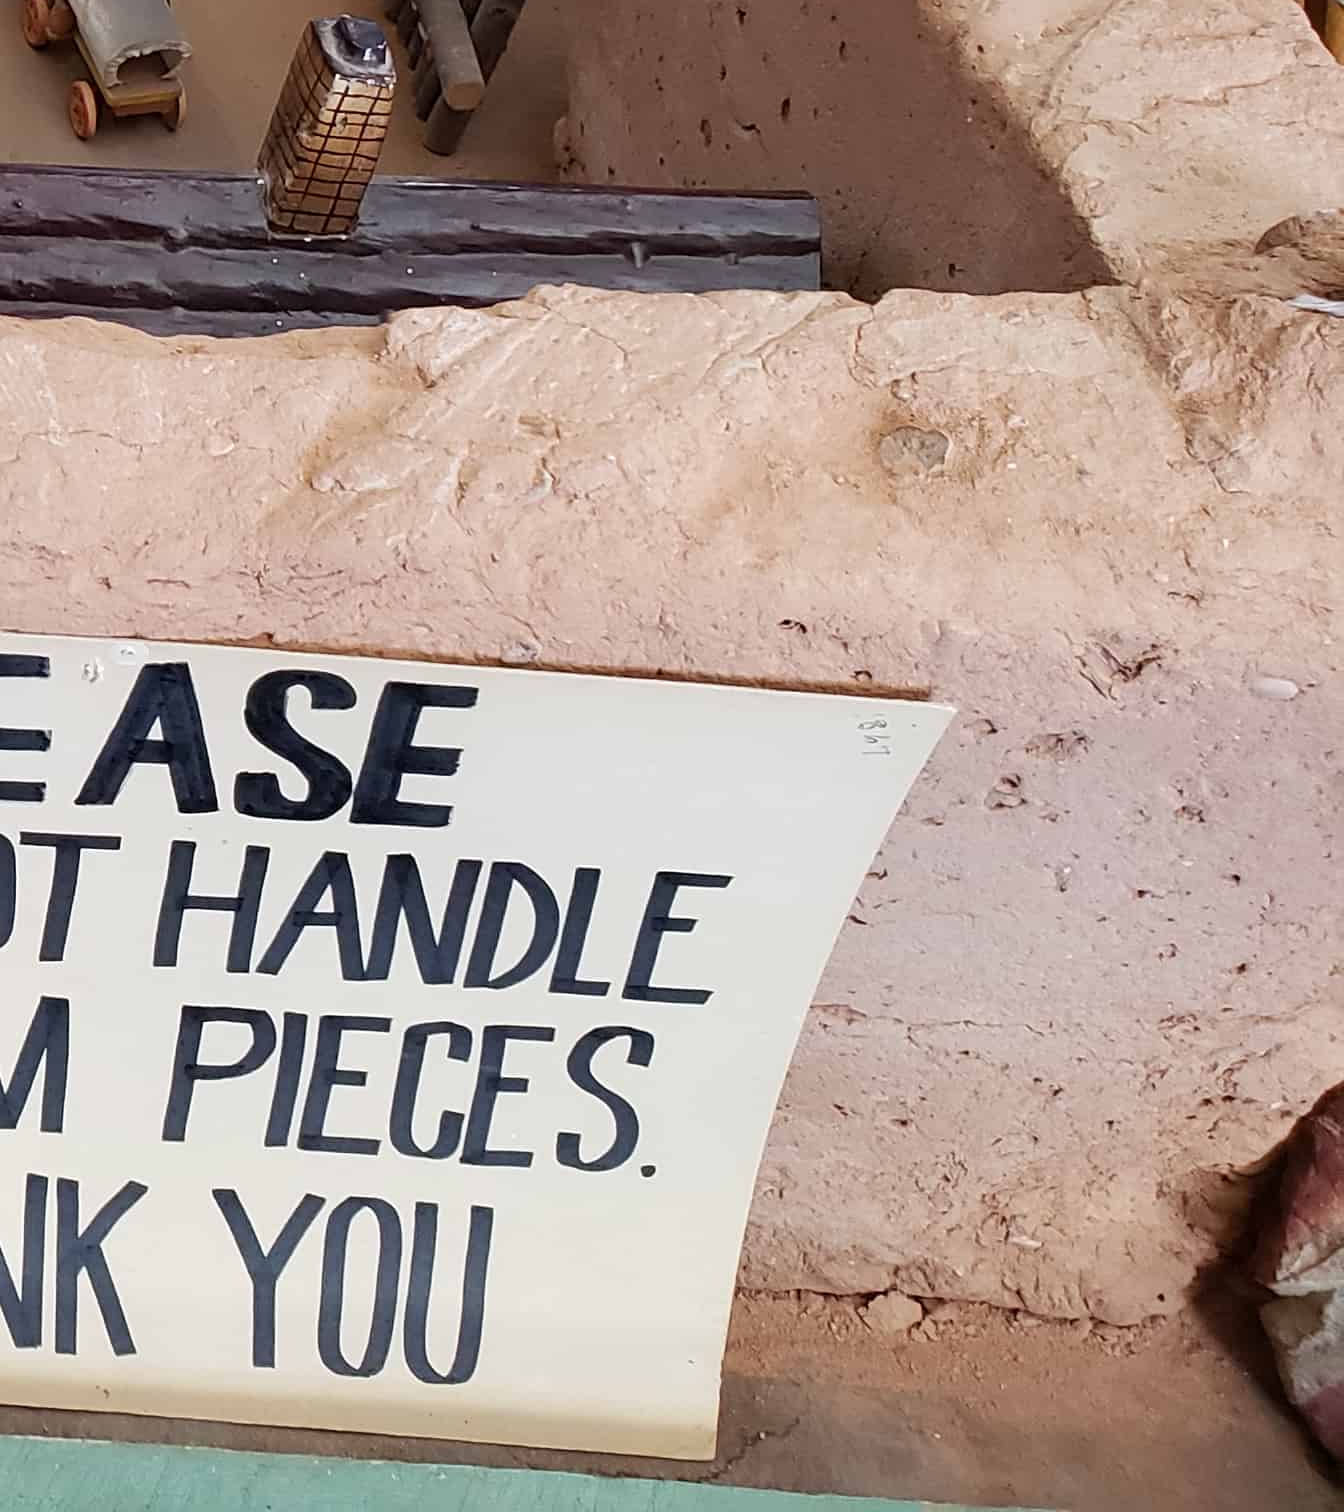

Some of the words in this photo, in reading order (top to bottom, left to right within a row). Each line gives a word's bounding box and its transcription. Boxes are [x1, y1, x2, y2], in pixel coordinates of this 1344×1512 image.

[154, 840, 733, 1004] HANDLE
[163, 1001, 664, 1177] PIECES.
[212, 1189, 493, 1384] YOU
